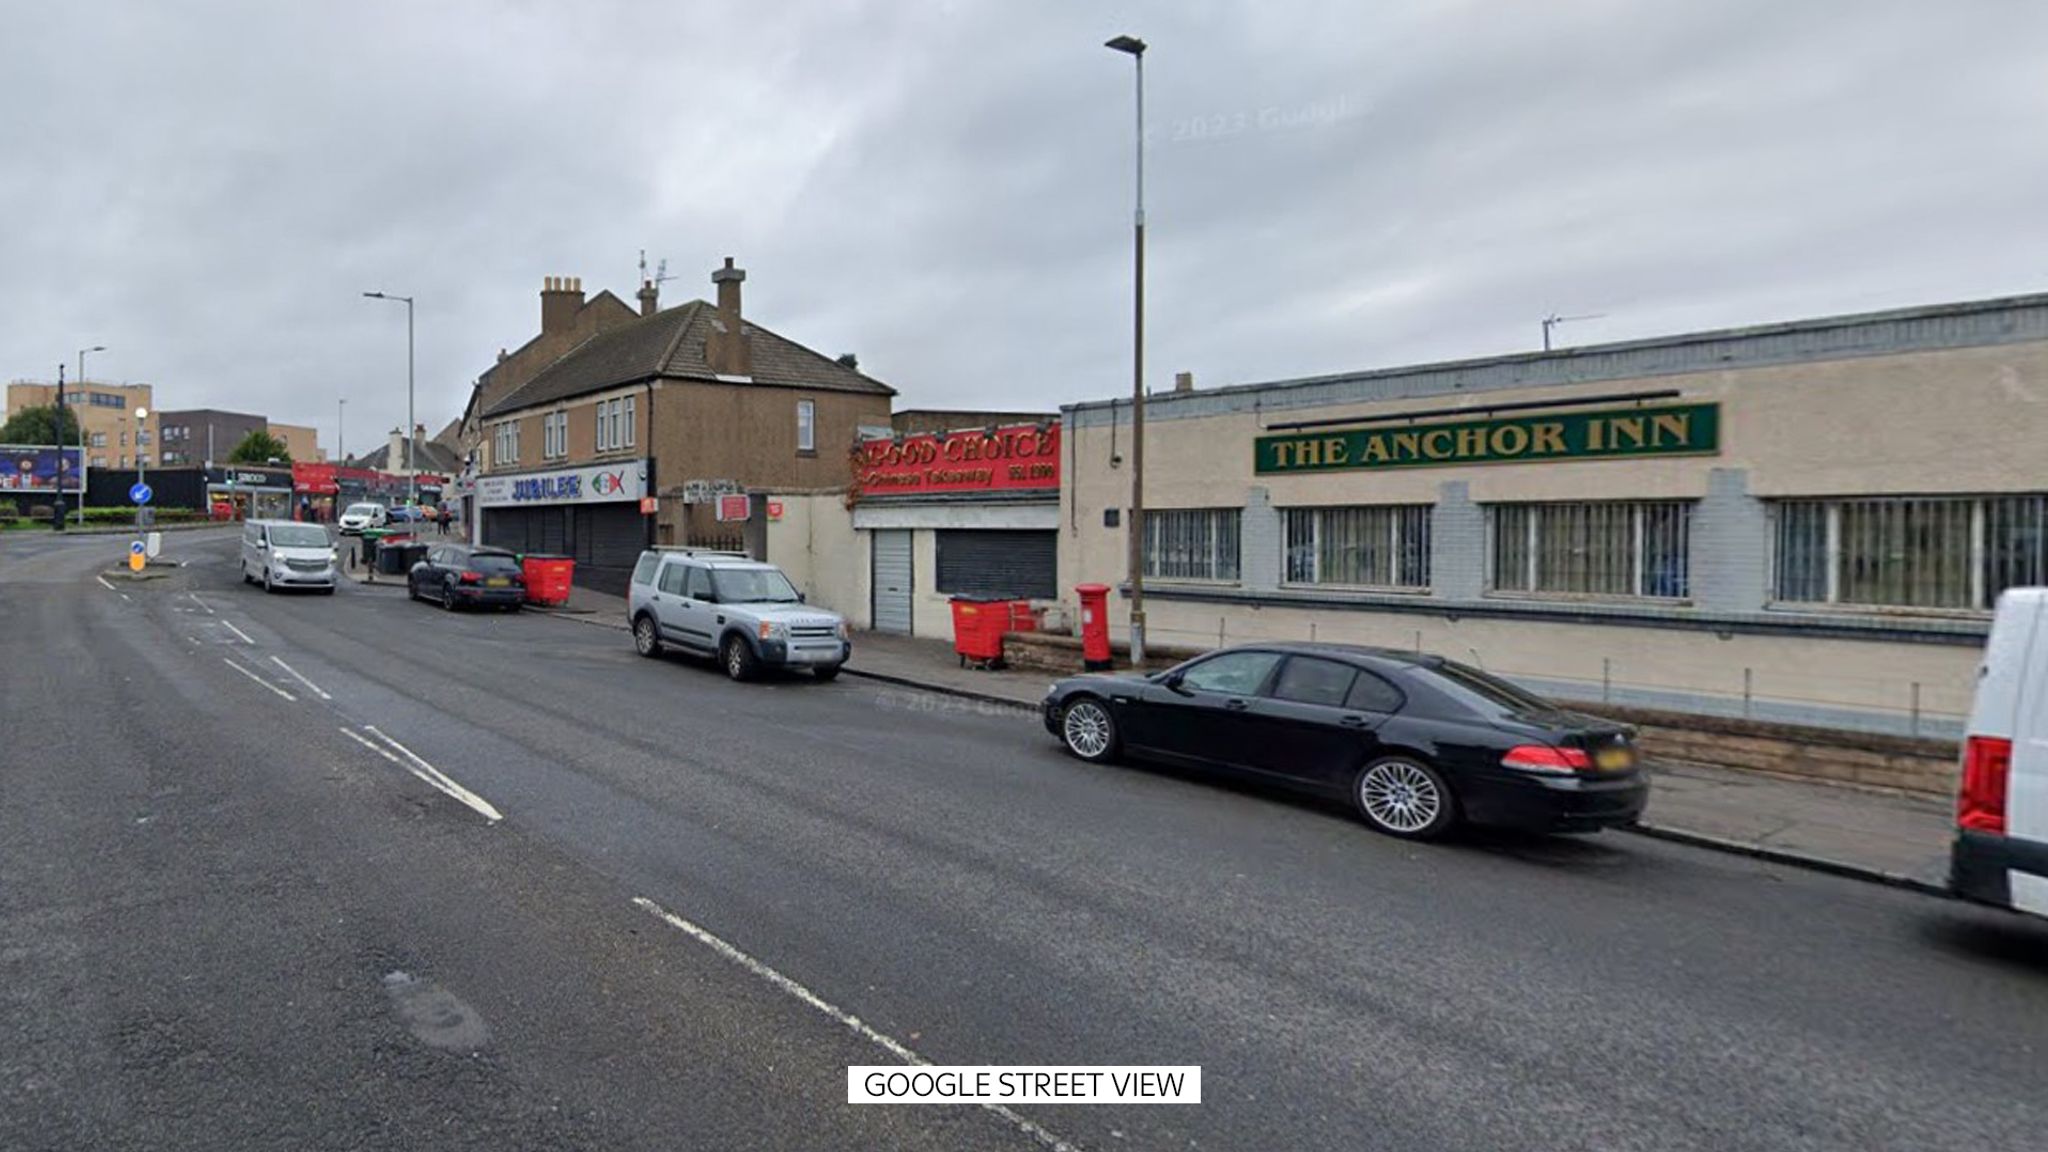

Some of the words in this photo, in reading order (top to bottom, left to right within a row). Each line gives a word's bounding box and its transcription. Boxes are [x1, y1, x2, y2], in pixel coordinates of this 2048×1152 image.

[944, 431, 1056, 463] CHOICE
[1271, 437, 1349, 467] THE
[1361, 420, 1568, 464] ANCHOR
[1586, 413, 1692, 450] INN
